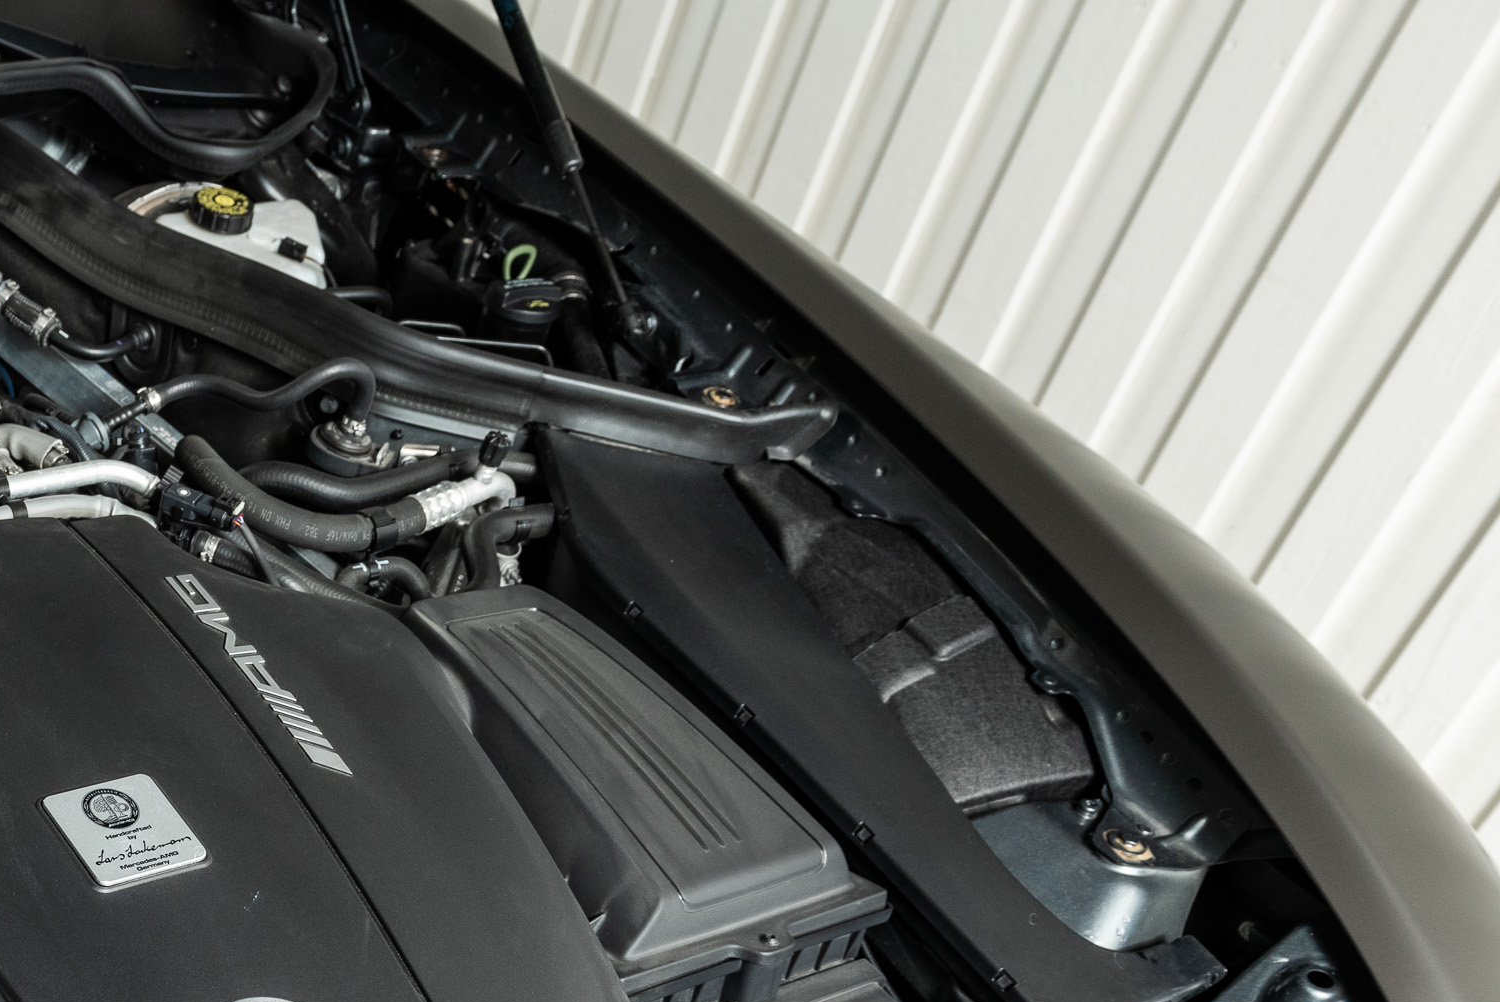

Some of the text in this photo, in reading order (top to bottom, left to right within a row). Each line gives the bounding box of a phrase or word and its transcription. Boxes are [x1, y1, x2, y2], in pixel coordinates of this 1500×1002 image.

[259, 506, 272, 522] DN
[273, 513, 292, 531] PHX
[165, 573, 297, 701] AMG
[105, 824, 152, 840] Handcrafted
[120, 850, 180, 870] Mercedes-AMG
[136, 859, 171, 872] Germany
